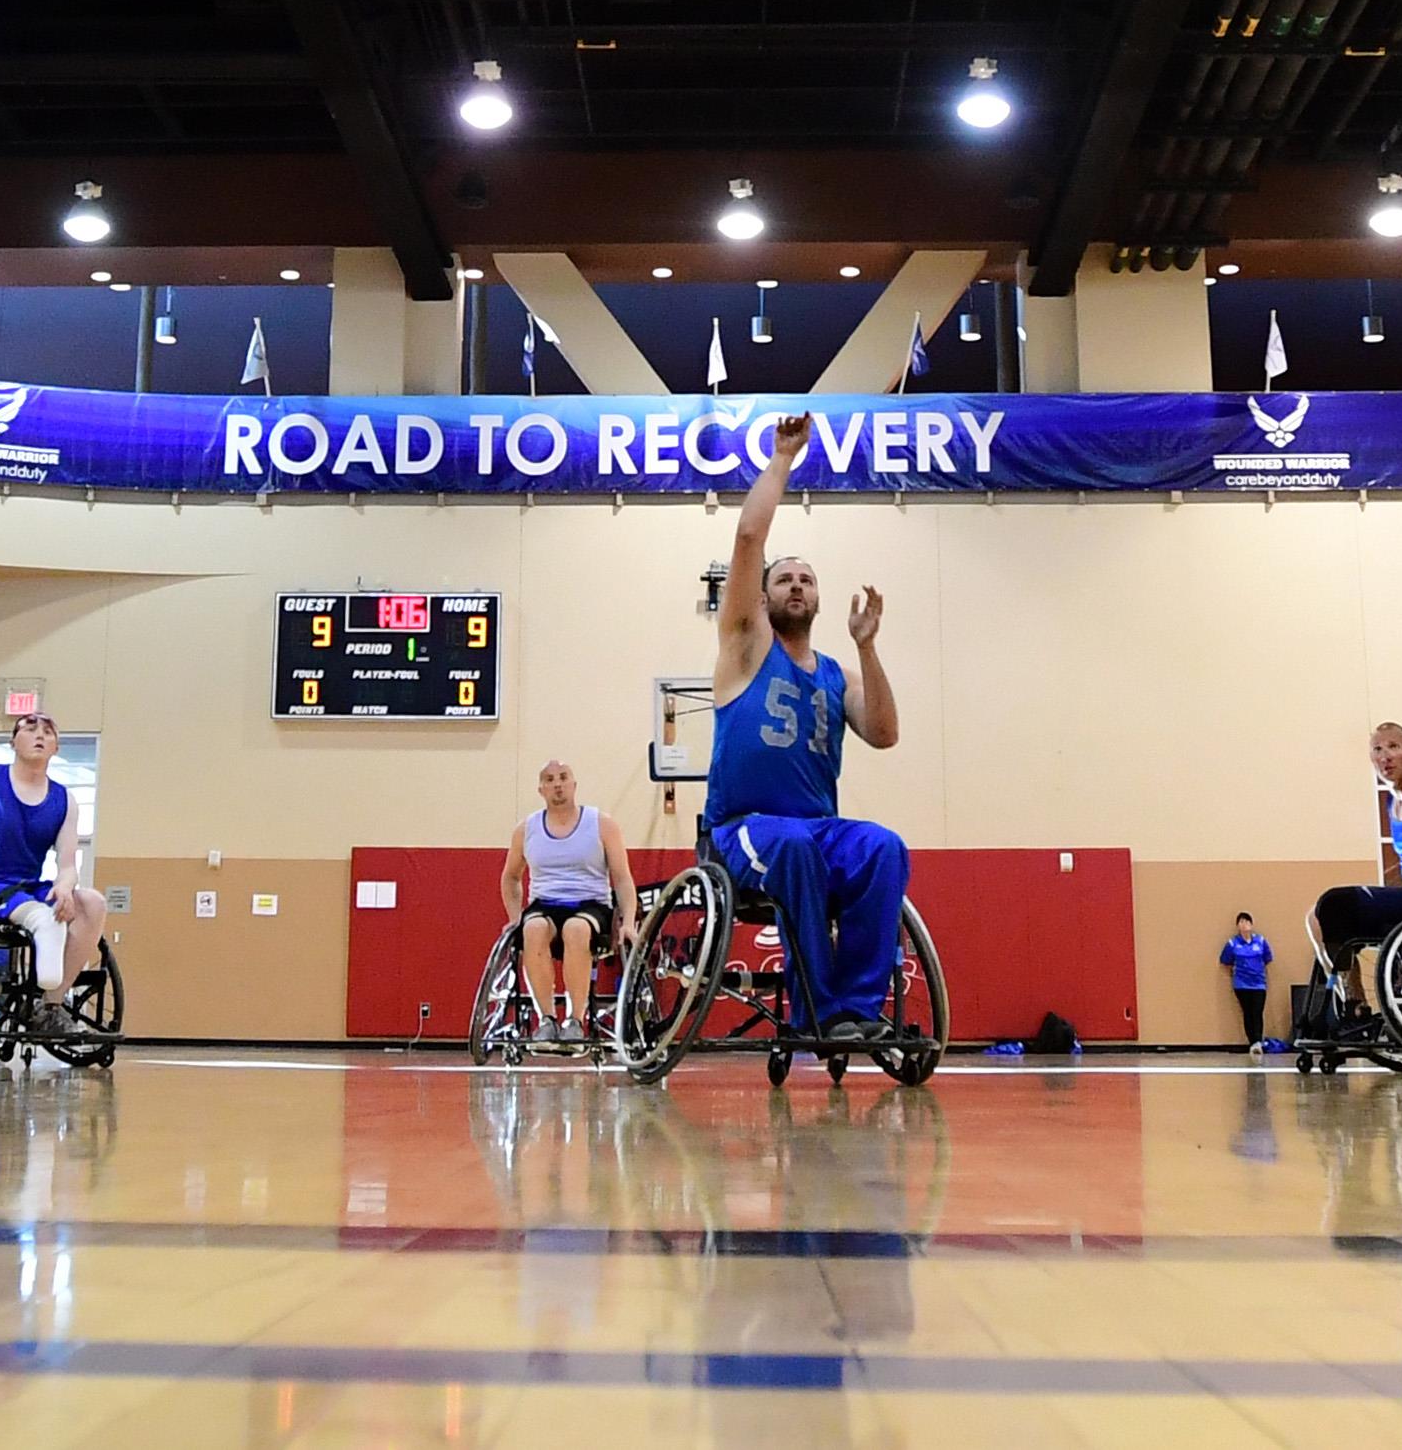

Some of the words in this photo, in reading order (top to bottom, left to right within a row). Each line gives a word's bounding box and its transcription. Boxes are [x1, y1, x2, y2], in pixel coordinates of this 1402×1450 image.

[223, 413, 443, 476] ROAD
[470, 414, 568, 476] TO
[598, 411, 1005, 476] RECOVERY
[1213, 459, 1283, 470] WOUNDED
[1284, 458, 1350, 470] WARRIOR
[1225, 473, 1341, 487] carebeyondduty
[284, 598, 337, 612] GUEST
[442, 598, 489, 612] HOME
[378, 597, 427, 629] 1:06
[312, 616, 332, 647] 9
[467, 616, 487, 648] 9
[345, 643, 393, 655] PERIOD
[407, 637, 415, 661] 1
[292, 669, 325, 679] FOULS
[352, 670, 420, 680] PLAYER-FOUL
[448, 669, 480, 680] FOULS
[9, 694, 34, 712] EXIT
[289, 705, 325, 715] POINTS
[352, 705, 388, 715] MATCH
[445, 706, 482, 716] POINTS
[760, 677, 829, 755] 51
